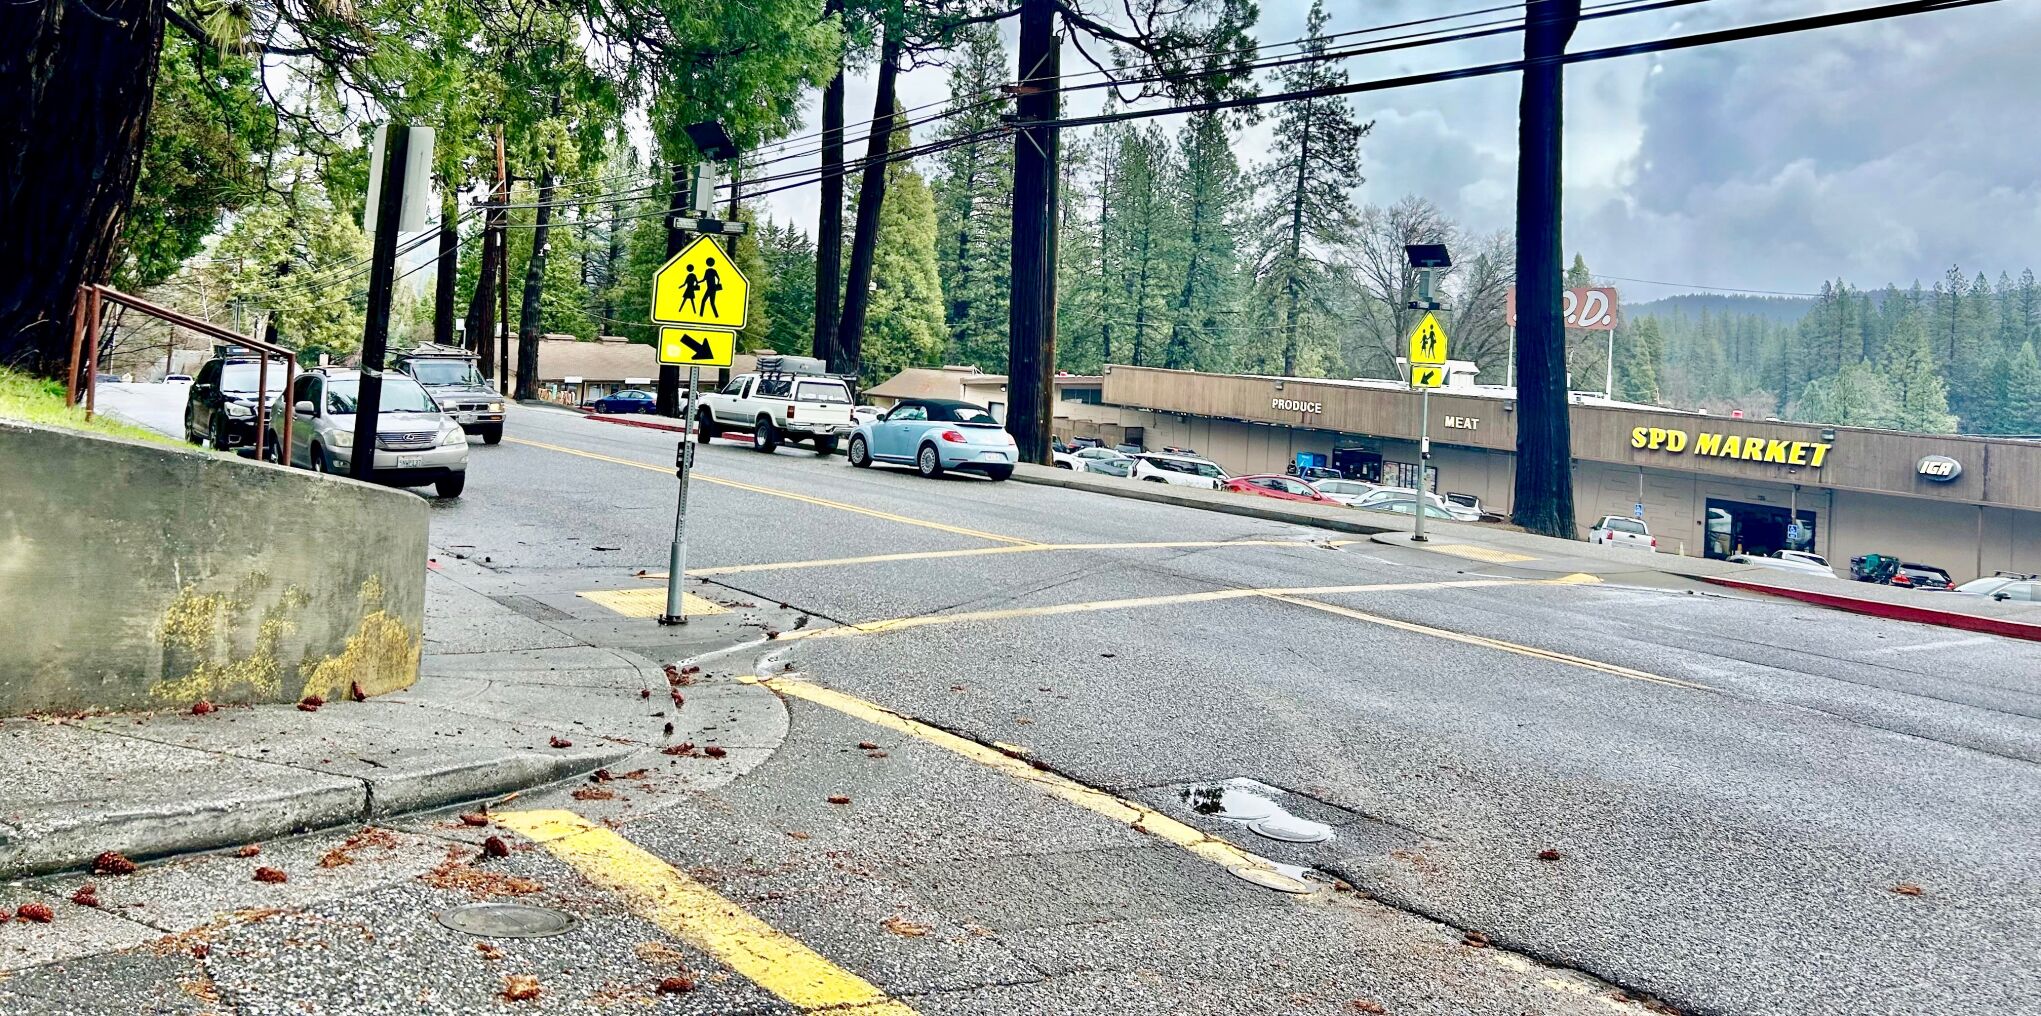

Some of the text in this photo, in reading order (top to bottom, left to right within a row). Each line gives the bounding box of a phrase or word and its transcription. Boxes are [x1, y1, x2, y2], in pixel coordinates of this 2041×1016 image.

[1271, 398, 1322, 414] PRODUCE
[1444, 415, 1480, 430] MEAT
[1631, 427, 1832, 467] SPD MARKET
[1919, 460, 1954, 476] IGA
